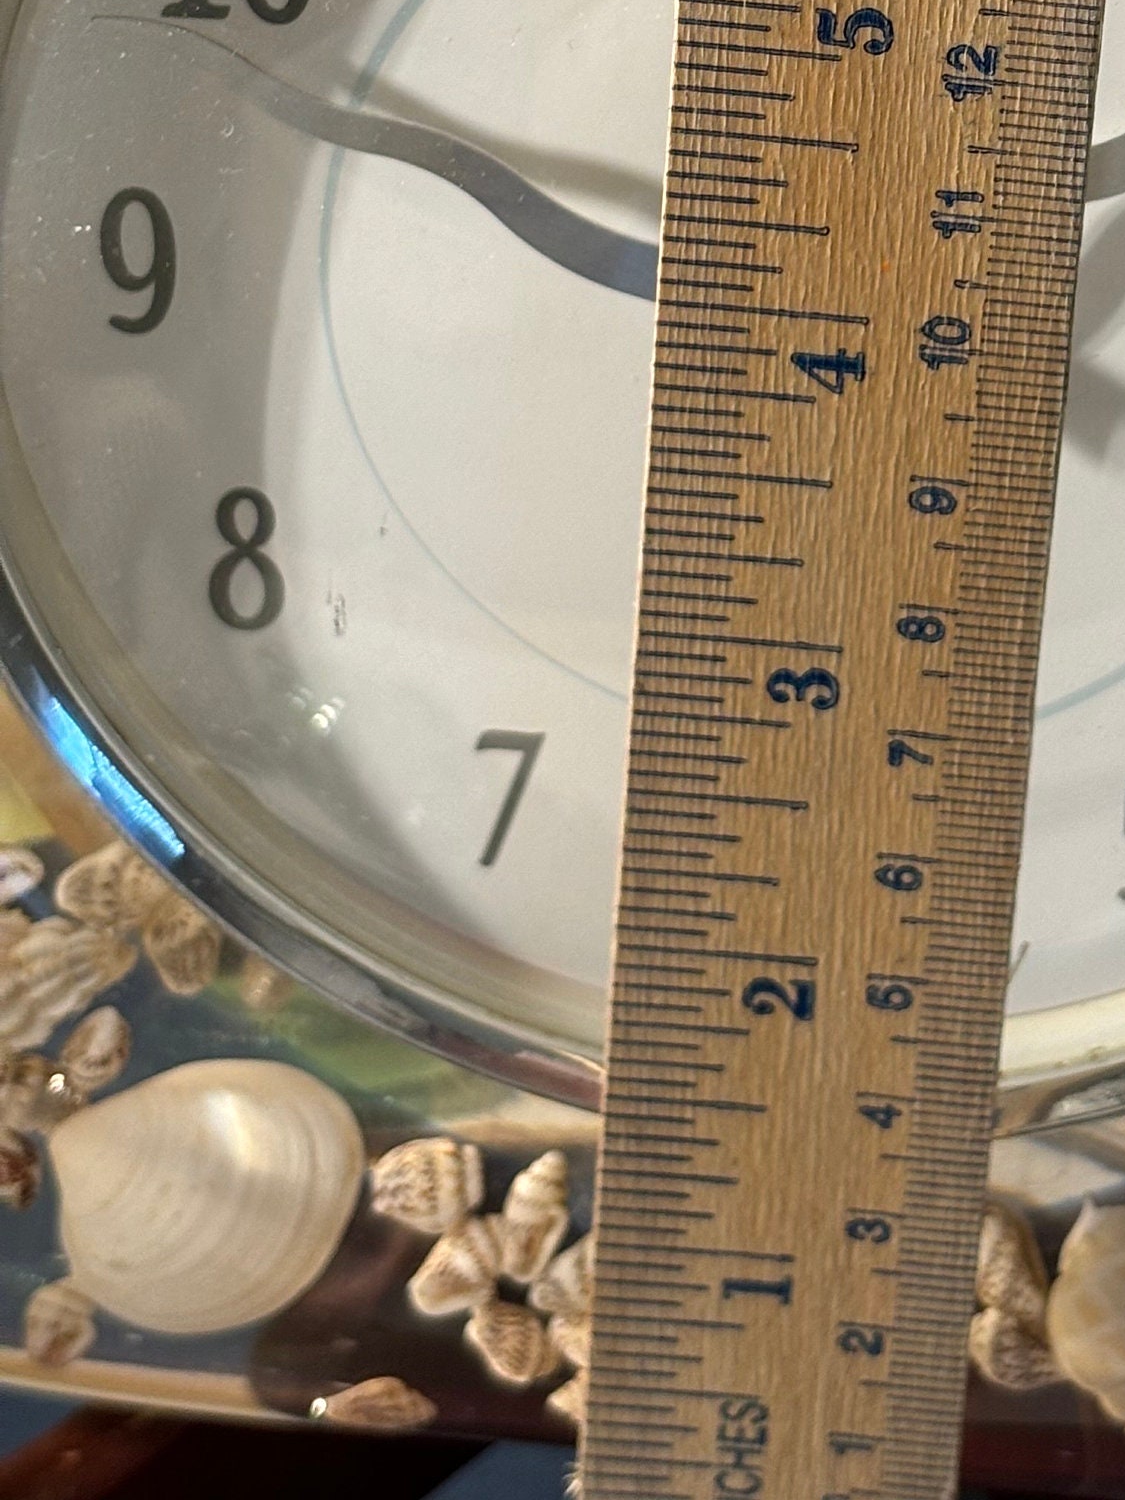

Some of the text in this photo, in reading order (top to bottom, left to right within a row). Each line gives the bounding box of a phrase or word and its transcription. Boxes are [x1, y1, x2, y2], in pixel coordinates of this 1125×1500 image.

[817, 8, 894, 55] 5
[943, 44, 998, 101] 12
[931, 189, 984, 238] 11
[100, 187, 177, 334] 9
[919, 315, 972, 370] 10
[790, 348, 866, 394] 4
[908, 485, 957, 516] 9
[208, 485, 285, 631] 8
[897, 615, 946, 643] 8
[766, 667, 840, 710] 3
[887, 739, 933, 766] 7
[475, 728, 546, 867] 7
[875, 863, 923, 892] 6
[742, 977, 817, 1021] 2
[858, 1103, 902, 1129] 4
[847, 1217, 892, 1244] 3
[722, 1277, 792, 1307] 1
[841, 1327, 884, 1357] 2
[713, 1399, 768, 1500] CHES
